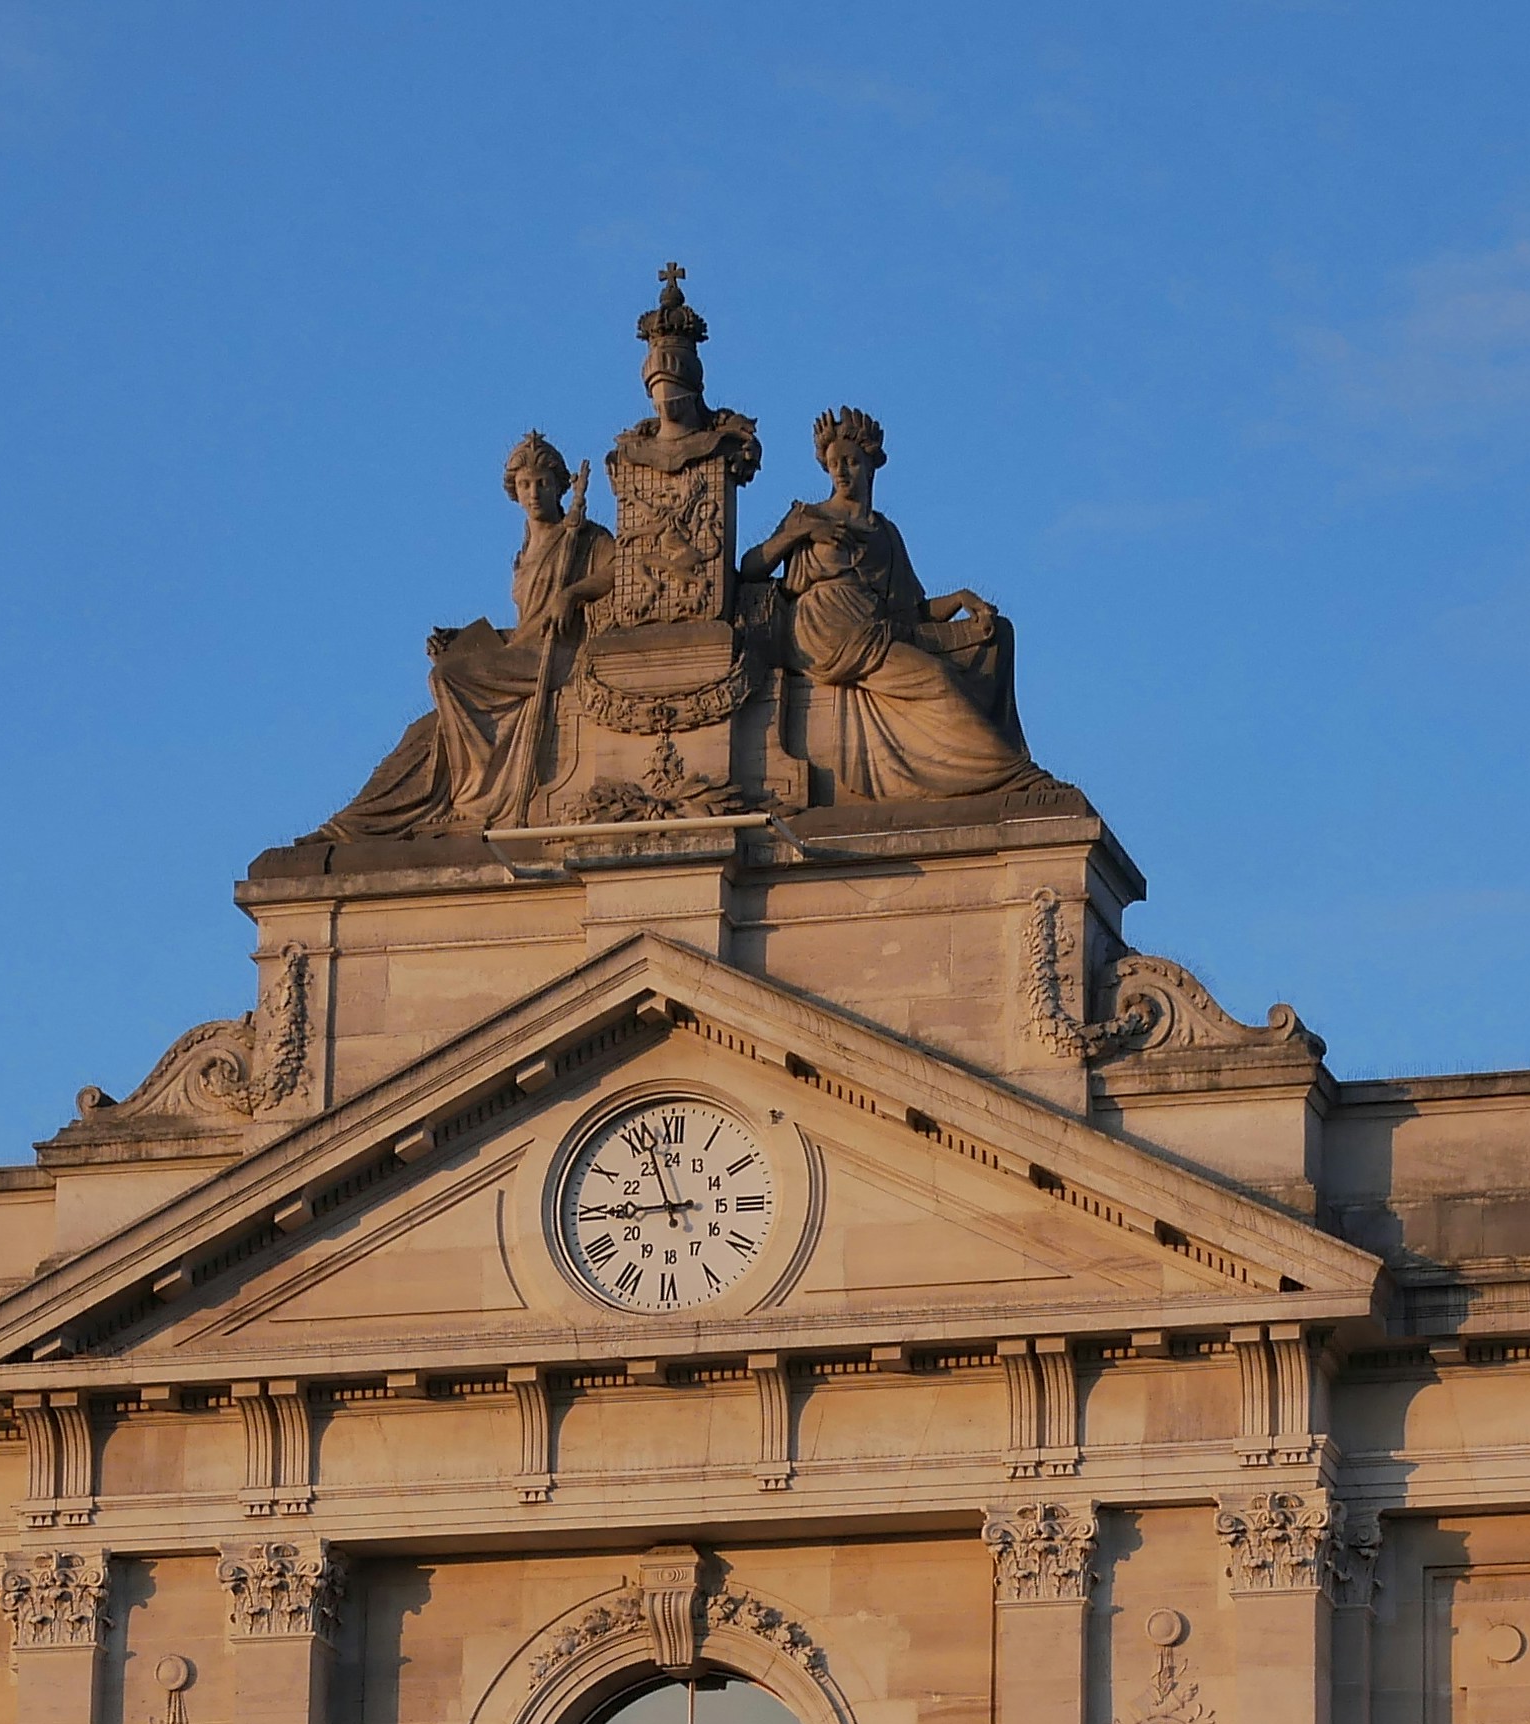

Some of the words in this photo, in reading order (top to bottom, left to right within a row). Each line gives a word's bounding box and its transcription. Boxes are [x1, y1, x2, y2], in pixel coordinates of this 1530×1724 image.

[662, 1116, 685, 1144] XII
[665, 1152, 681, 1168] 24
[691, 1158, 704, 1174] 13
[726, 1153, 755, 1177] II
[591, 1163, 620, 1184] X
[641, 1161, 657, 1176] 23
[624, 1180, 640, 1195] 22
[708, 1175, 721, 1191] 14
[715, 1198, 728, 1213] 15
[736, 1195, 765, 1212] III
[579, 1203, 608, 1222] IX
[624, 1226, 640, 1241] 20
[708, 1222, 721, 1237] 16
[584, 1232, 619, 1271] VIII
[641, 1243, 653, 1259] 19
[689, 1241, 702, 1256] 17
[725, 1230, 755, 1258] IV
[664, 1249, 677, 1265] 18
[615, 1261, 644, 1296] VII
[702, 1262, 721, 1289] V
[660, 1272, 677, 1301] VI
